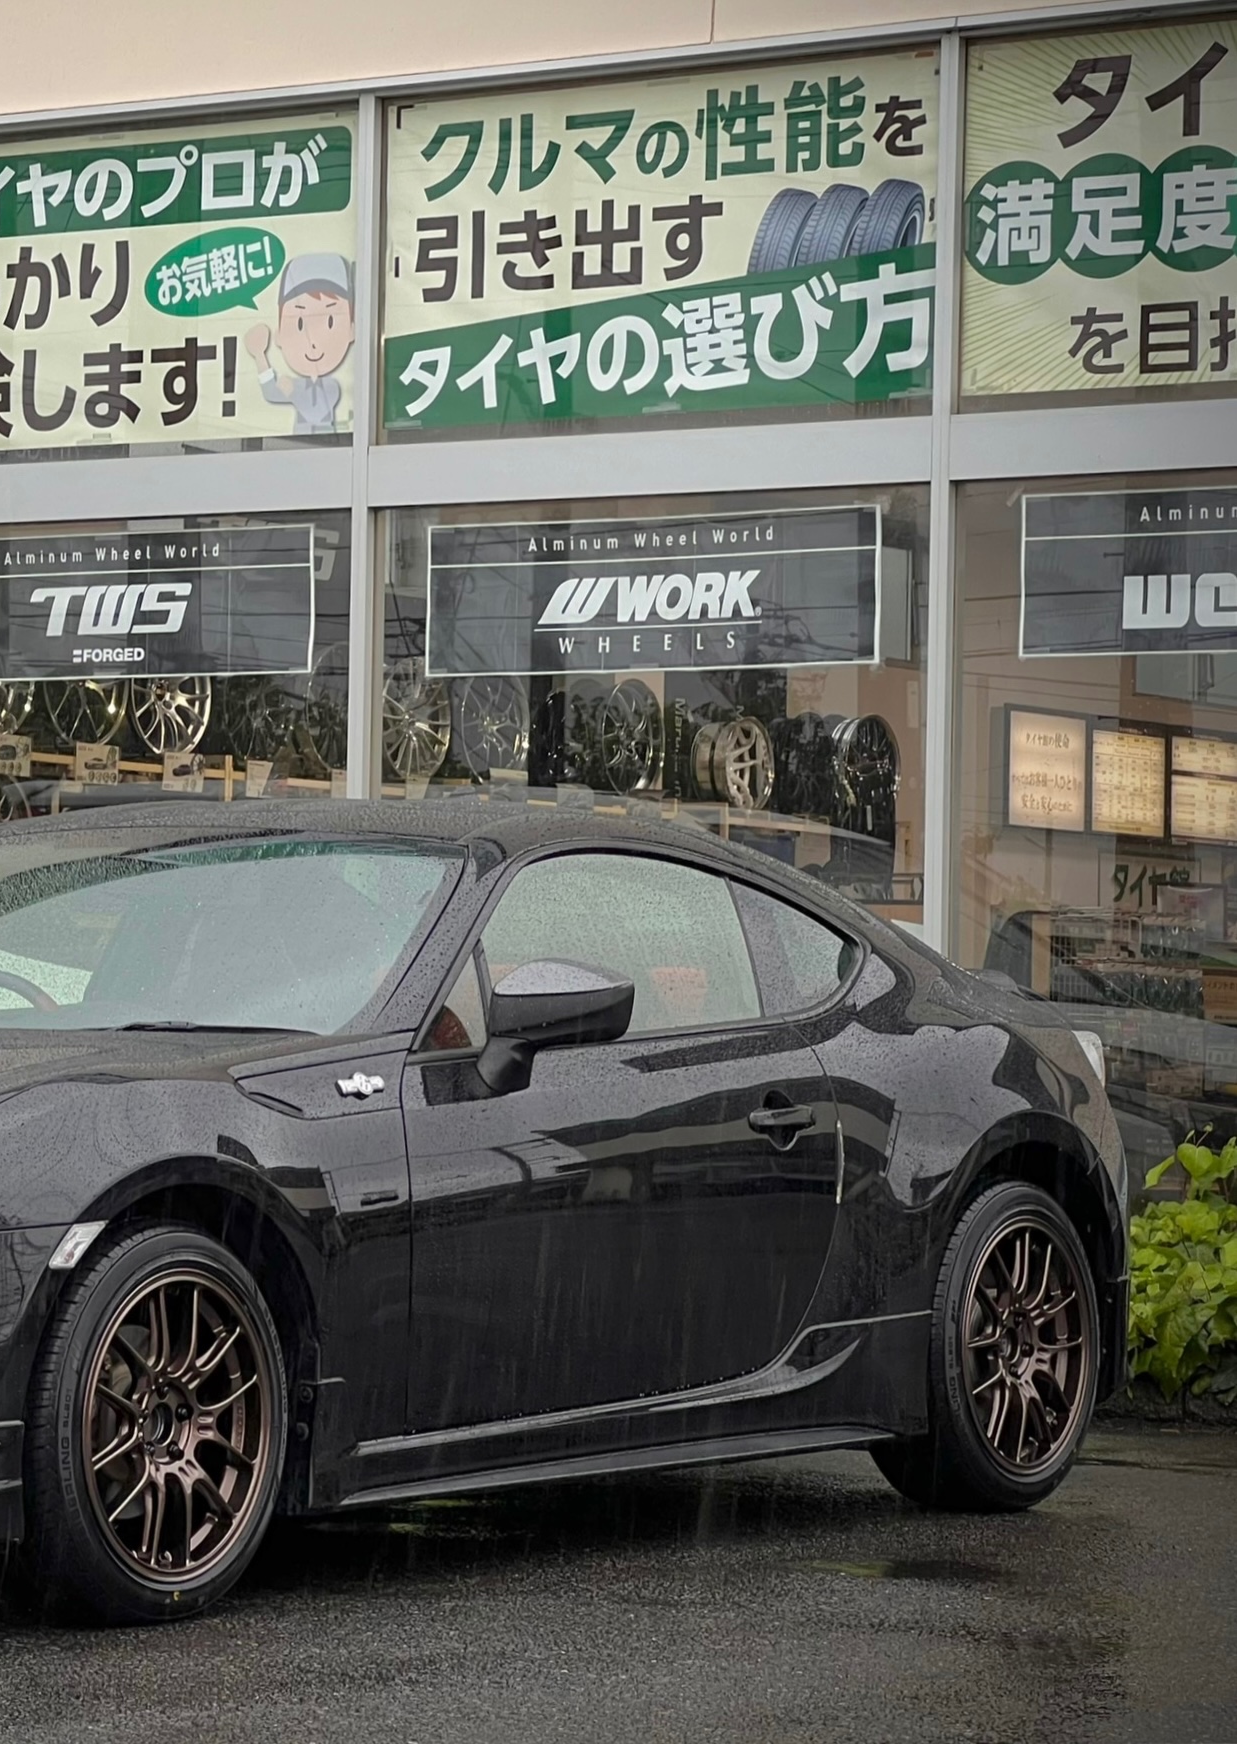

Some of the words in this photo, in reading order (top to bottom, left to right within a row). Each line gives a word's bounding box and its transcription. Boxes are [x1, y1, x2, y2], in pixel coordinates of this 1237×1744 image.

[1053, 41, 1229, 149] タイ
[420, 75, 927, 201] クルマの性能を
[975, 164, 1237, 267] 満足度
[156, 236, 274, 306] お気軽に!
[415, 195, 723, 302] 引き出す
[398, 262, 936, 417] タイヤの選び方
[4, 550, 83, 566] Alminum
[95, 546, 151, 561] Wheel
[164, 543, 220, 559] World
[528, 534, 619, 552] Alminum
[634, 530, 697, 547] Wheel
[712, 525, 775, 544] World
[30, 582, 193, 637] TWS
[612, 569, 760, 623] WORK
[82, 647, 145, 663] FORGED
[558, 630, 736, 654] WHEELS
